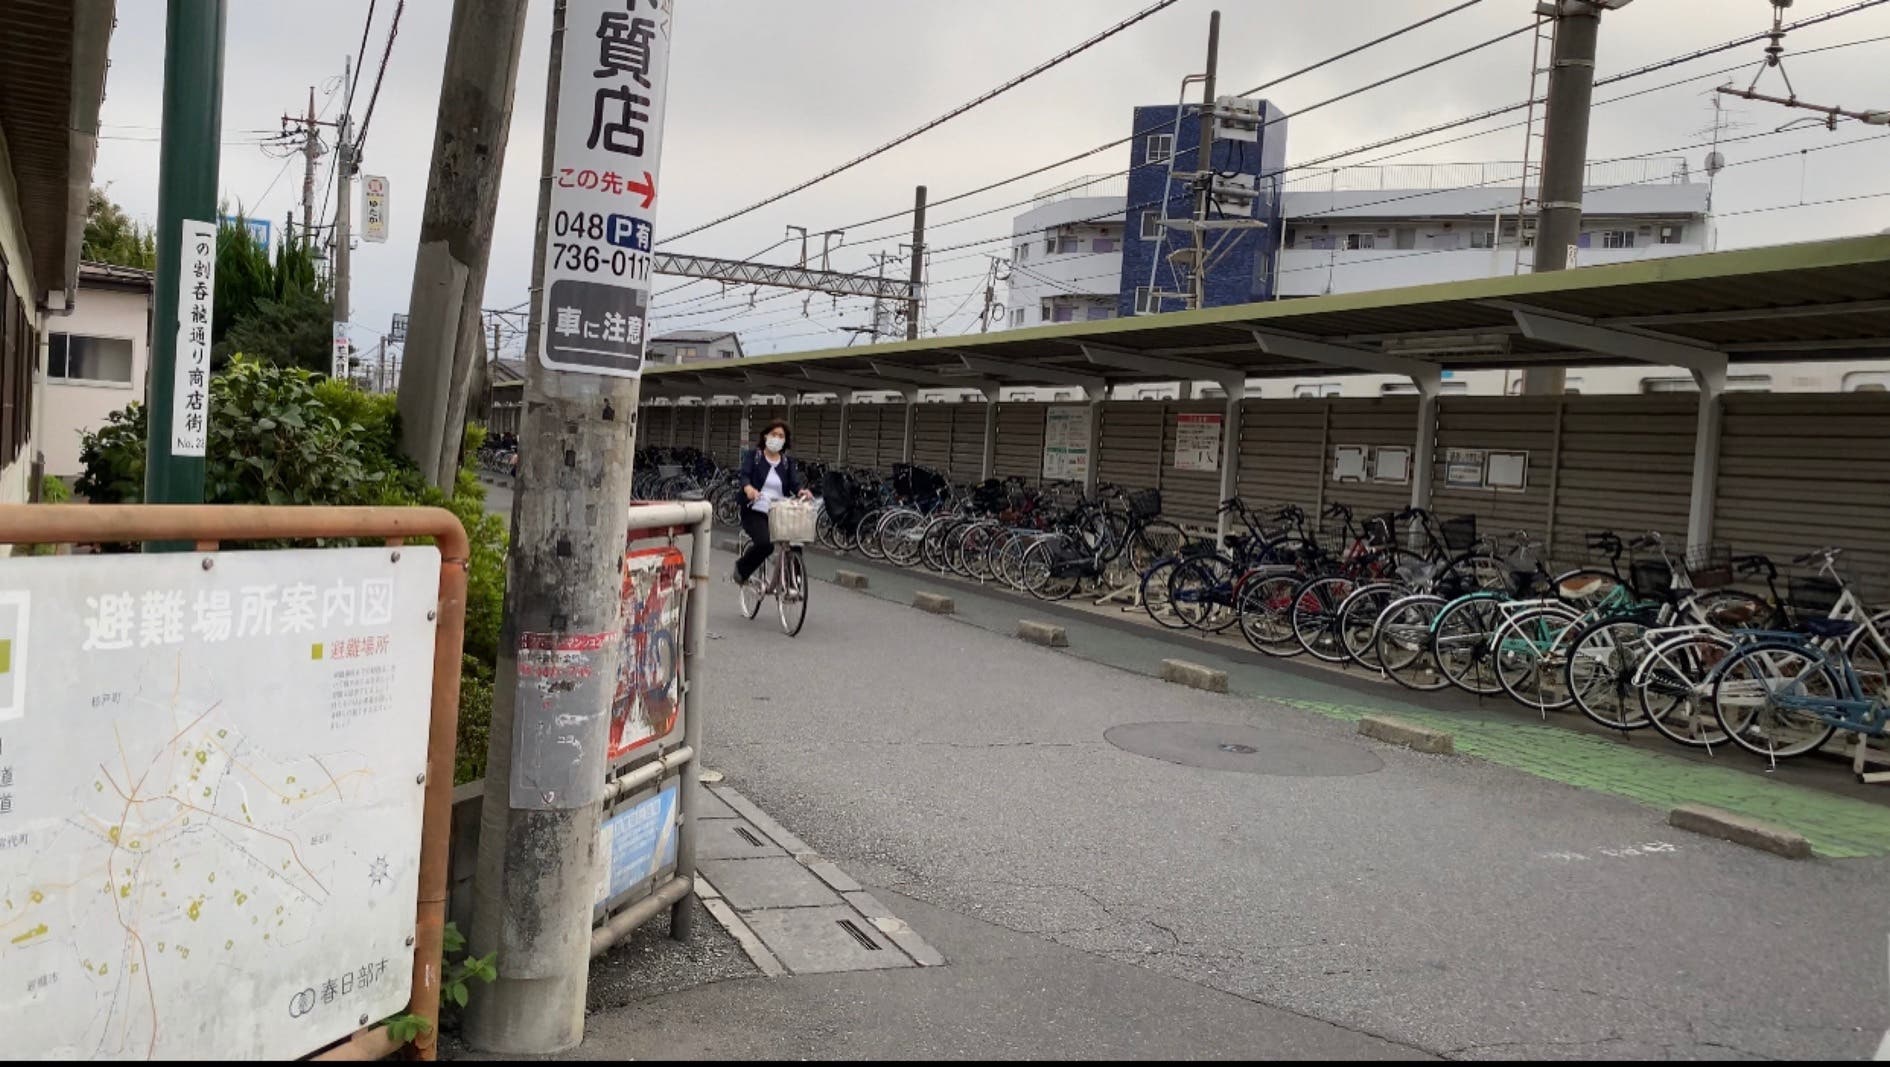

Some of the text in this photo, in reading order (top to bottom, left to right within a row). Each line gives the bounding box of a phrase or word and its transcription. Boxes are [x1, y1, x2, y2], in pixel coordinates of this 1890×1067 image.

[587, 0, 656, 157] 質店
[558, 168, 623, 195] この先
[554, 210, 604, 240] 048
[552, 243, 650, 281] 736-0117
[554, 306, 642, 345] 車に注意
[82, 578, 394, 652] 避難場所案内図
[330, 634, 390, 660] 避難場所
[321, 959, 389, 1004] 春日部市
